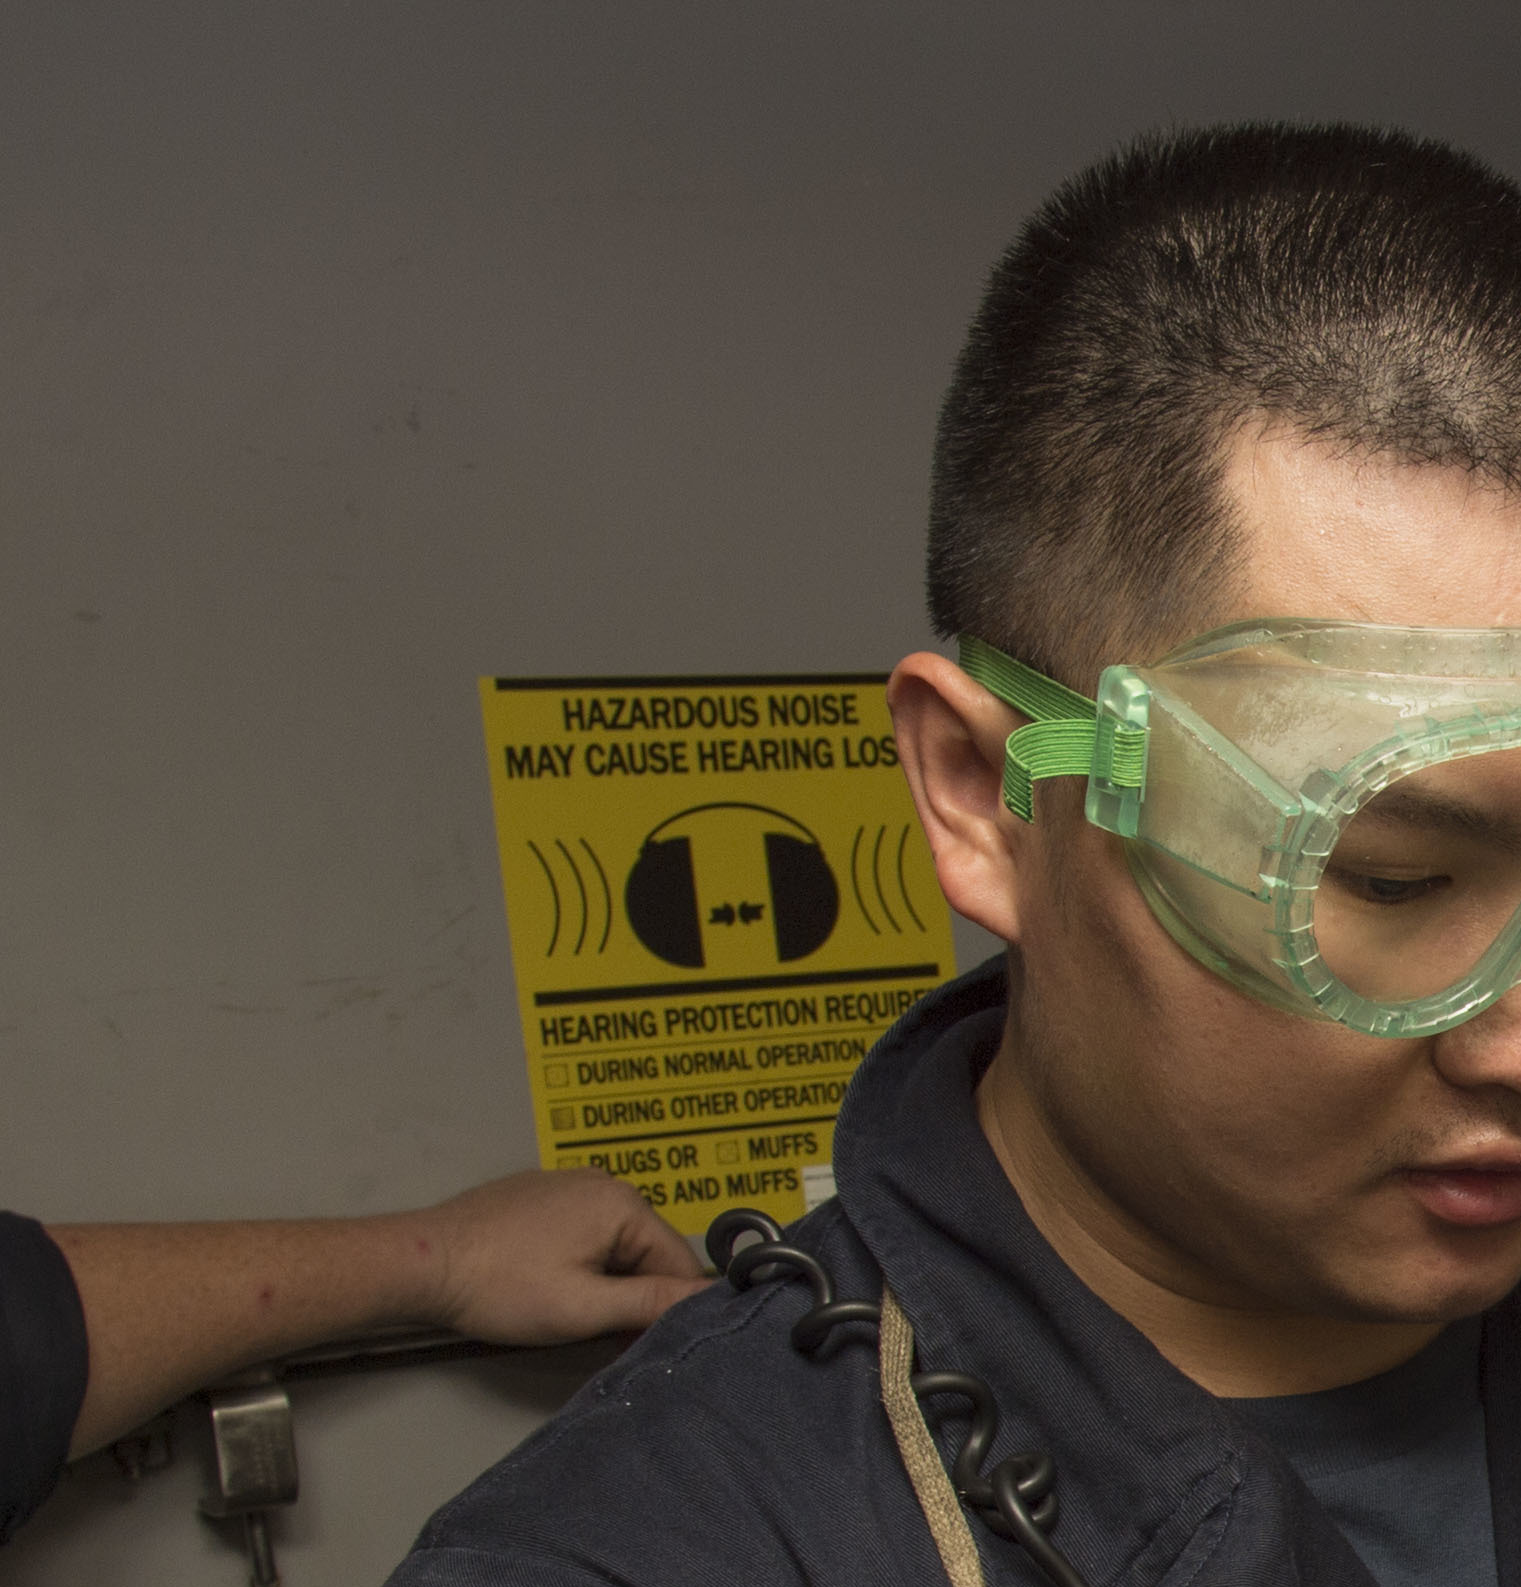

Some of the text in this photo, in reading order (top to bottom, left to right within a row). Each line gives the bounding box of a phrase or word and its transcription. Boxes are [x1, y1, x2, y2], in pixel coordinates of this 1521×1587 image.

[561, 693, 861, 732] HAZARDOUS NOISE
[504, 734, 900, 779] MAY CAUSE HEARING LOS
[539, 987, 935, 1048] HEARING PROTECTION REQUIR
[577, 1037, 866, 1086] DURING NORMAL OPERATION
[582, 1098, 666, 1129] DURING
[670, 1089, 740, 1120] OTHER
[590, 1132, 819, 1176] PLUGS OR MUFFS
[673, 1176, 720, 1205] AND
[726, 1168, 799, 1197] MUFFS
